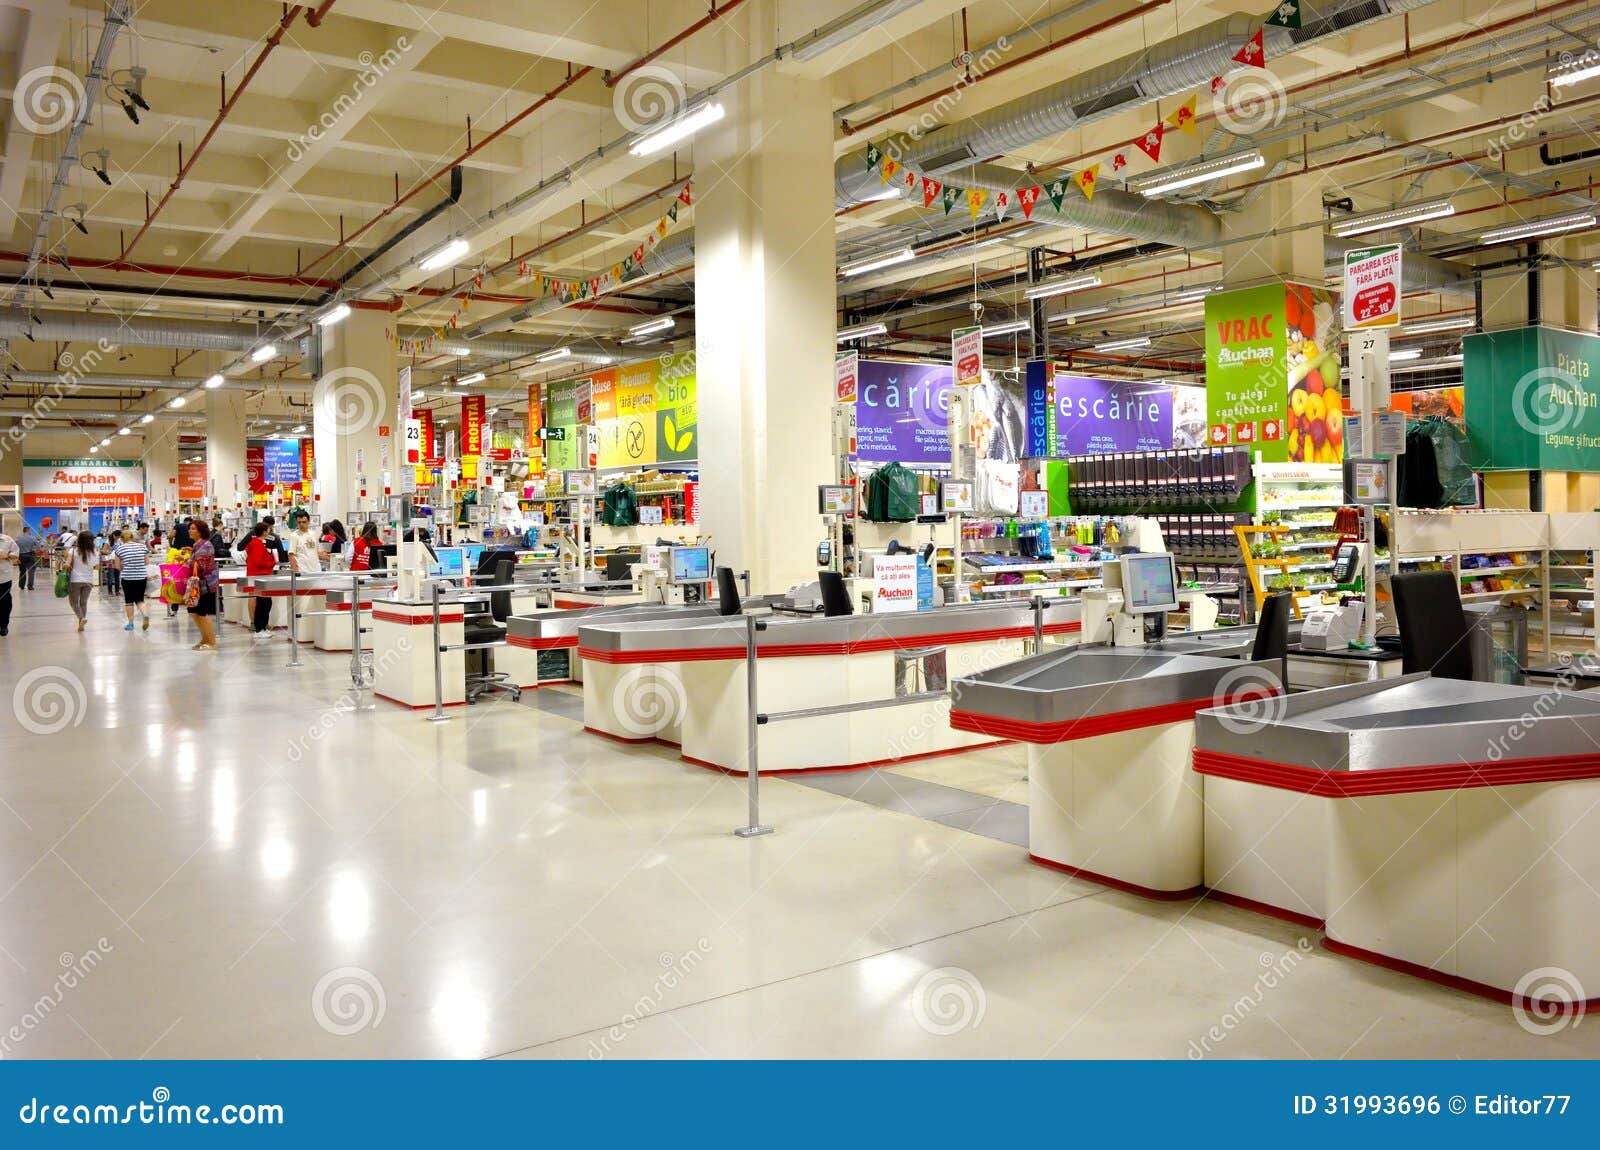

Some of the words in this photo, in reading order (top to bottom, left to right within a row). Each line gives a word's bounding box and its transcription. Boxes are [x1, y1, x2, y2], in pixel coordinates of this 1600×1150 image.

[1350, 260, 1382, 276] PARCAREA
[1383, 253, 1399, 265] ESTE
[1217, 314, 1273, 345] VRAC
[1364, 340, 1374, 349] 27
[1218, 346, 1274, 362] Auchan
[1226, 392, 1237, 402] Tu
[1240, 388, 1268, 402] alegi
[1550, 383, 1597, 408] Auchan
[1216, 402, 1278, 417] cantitatea!
[408, 428, 419, 440] 23
[588, 432, 597, 444] 24
[1546, 432, 1574, 448] Legume
[52, 470, 116, 484] Auchan
[878, 588, 912, 598] Auchan
